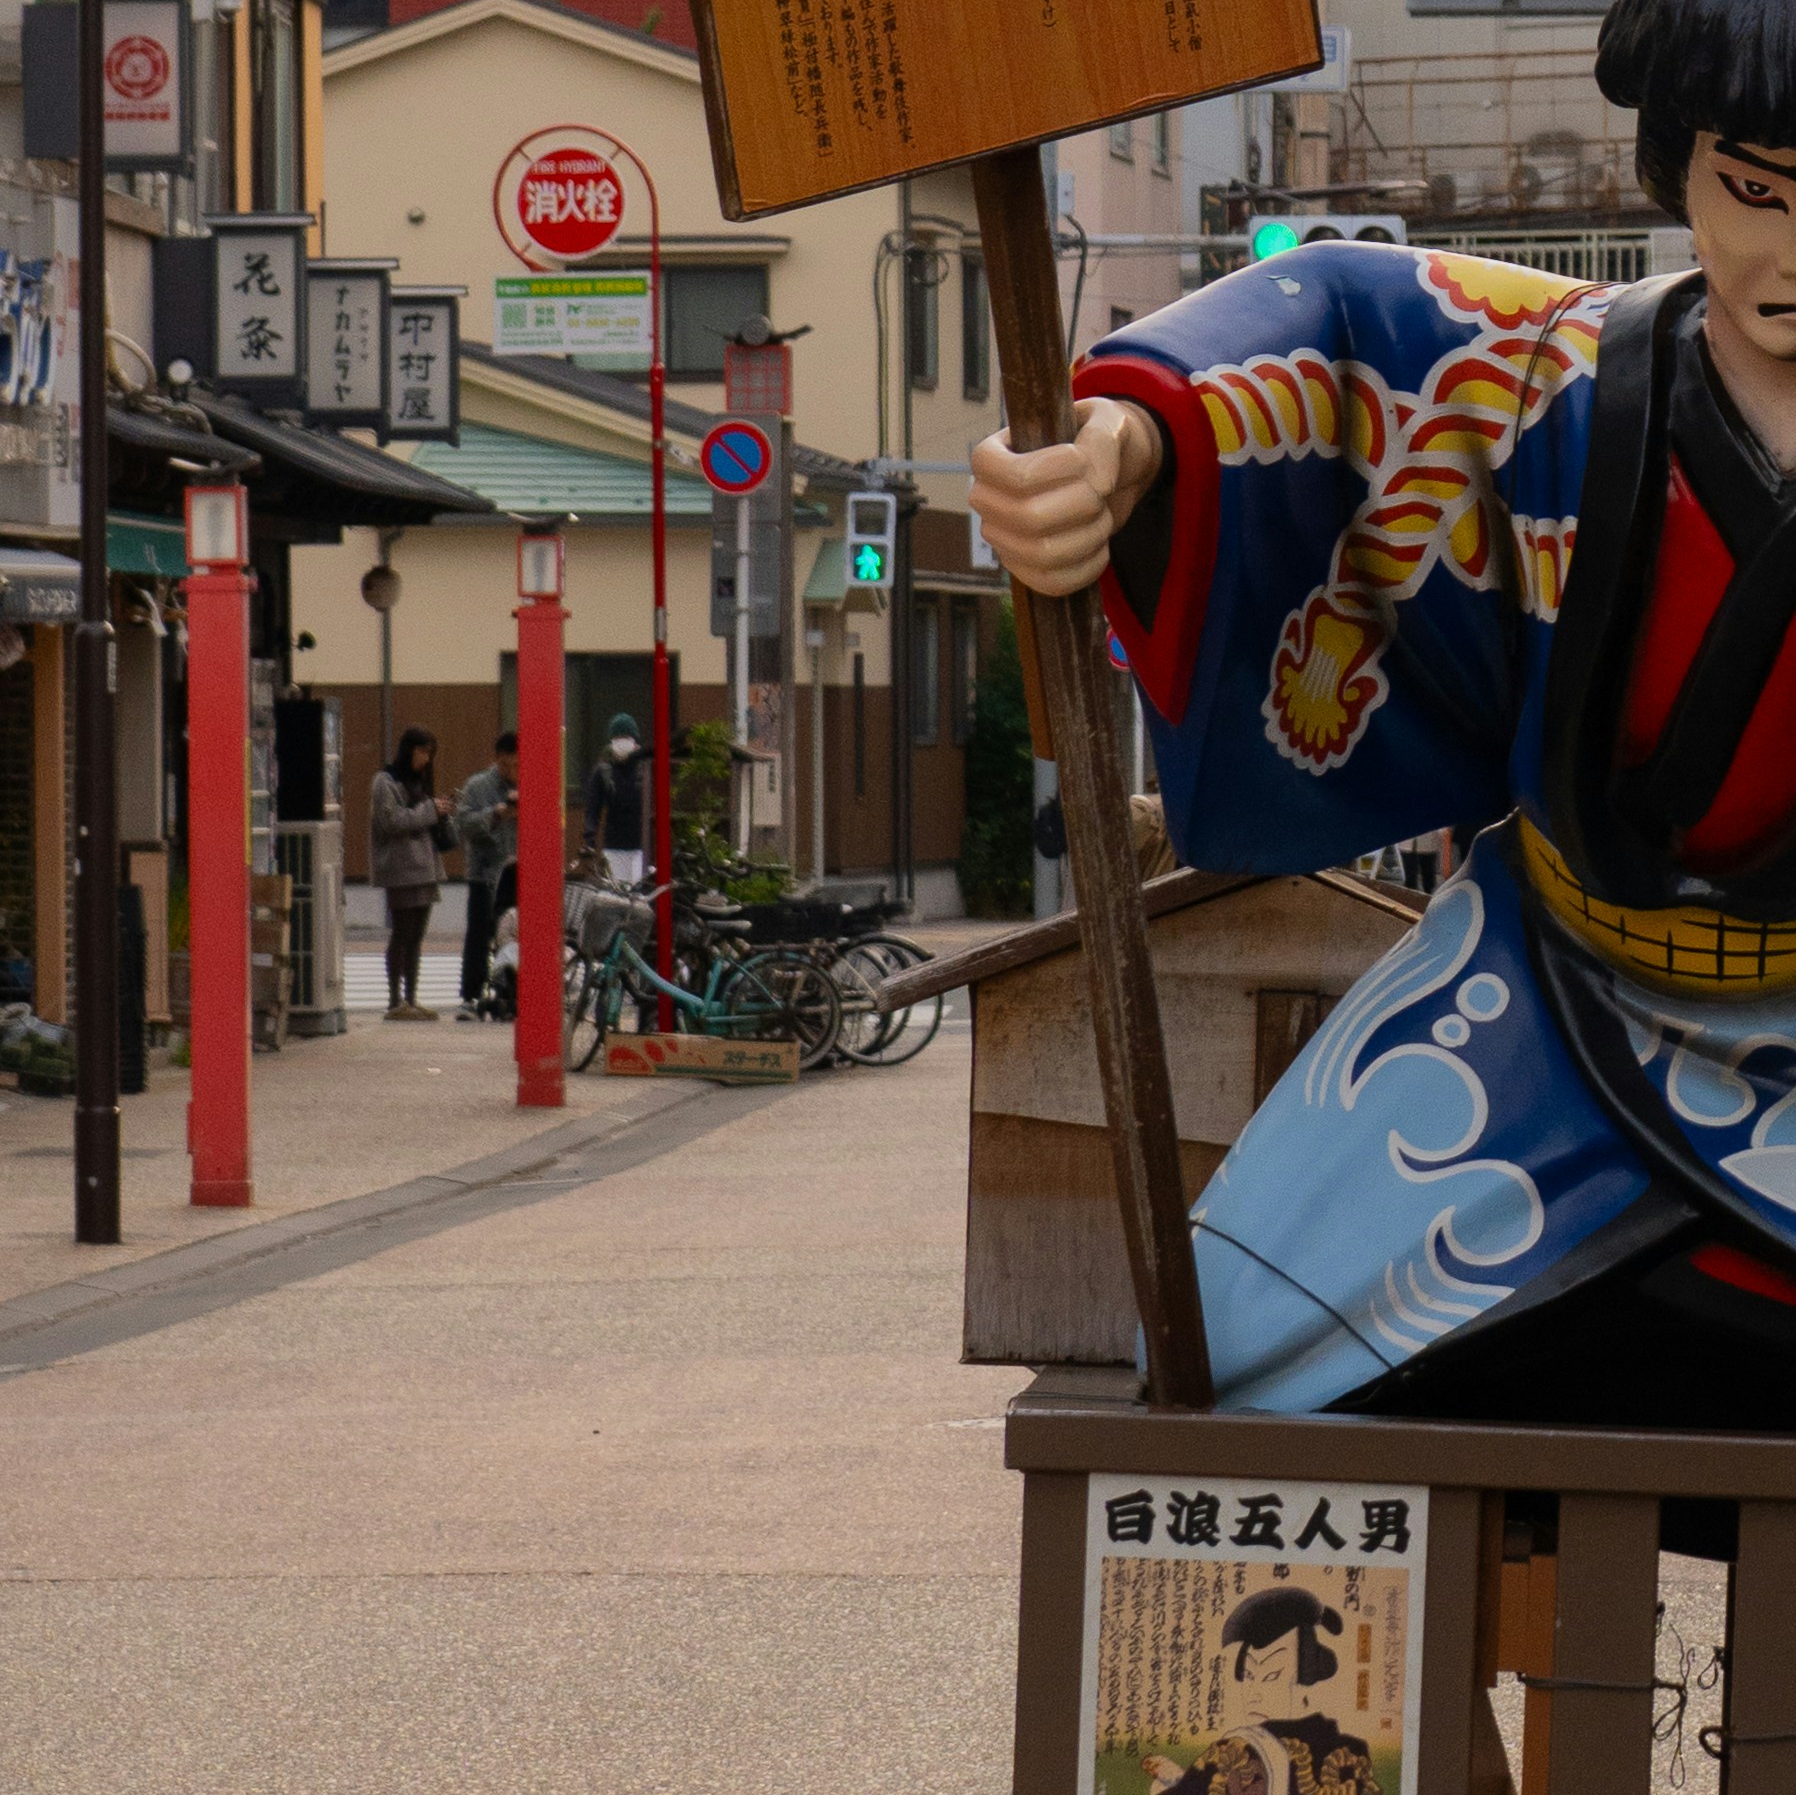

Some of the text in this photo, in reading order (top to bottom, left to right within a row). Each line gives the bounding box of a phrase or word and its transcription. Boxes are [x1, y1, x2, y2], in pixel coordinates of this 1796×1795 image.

[525, 178, 617, 224] 消火栓
[397, 310, 437, 422] 中村屋
[1104, 1488, 1411, 1555] 白浪五人男
